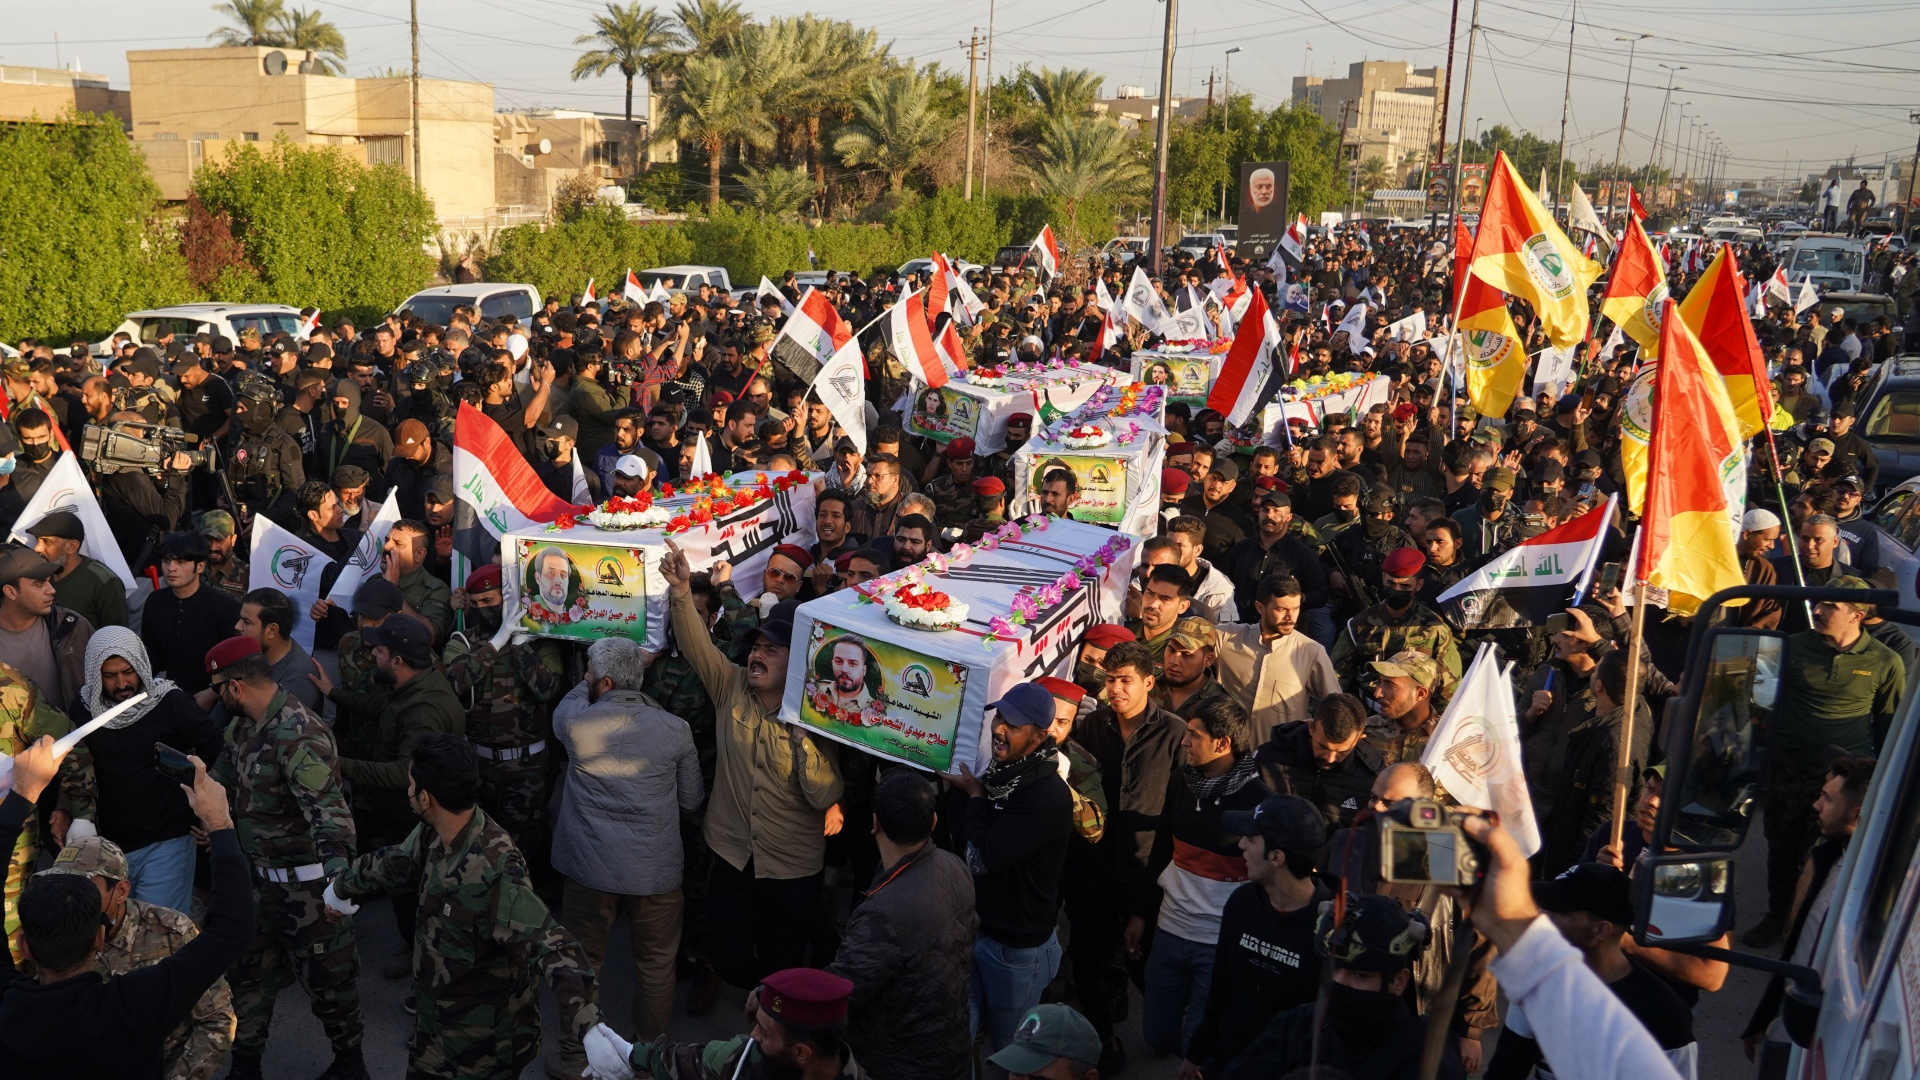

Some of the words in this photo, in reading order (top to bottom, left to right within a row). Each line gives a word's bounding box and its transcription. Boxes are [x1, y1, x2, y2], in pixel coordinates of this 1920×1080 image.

[1489, 555, 1528, 582] اكبر
[1535, 553, 1563, 576] الله
[610, 589, 633, 599] الشهيد
[625, 613, 637, 624] علي
[913, 706, 942, 721] الشهيد
[904, 725, 926, 739] مهدي
[926, 732, 949, 747] صلاح
